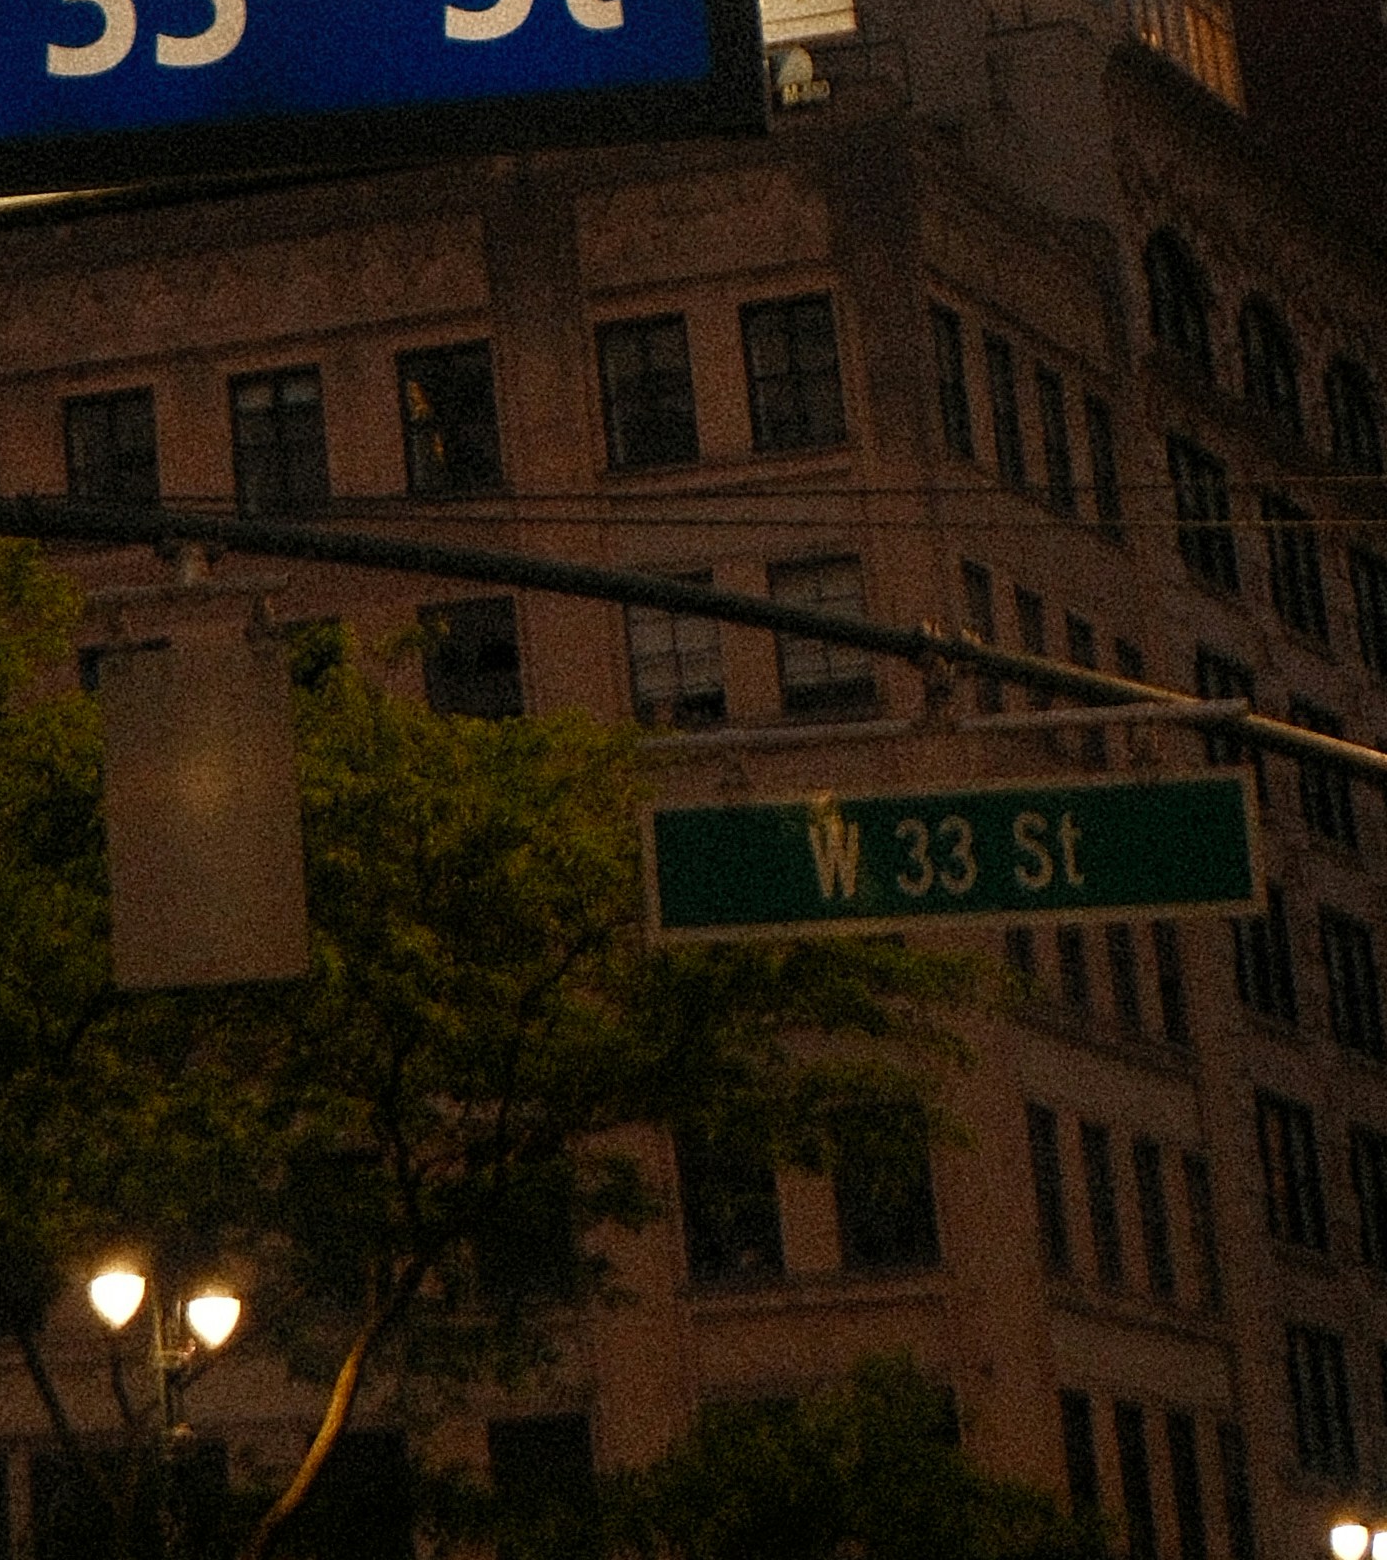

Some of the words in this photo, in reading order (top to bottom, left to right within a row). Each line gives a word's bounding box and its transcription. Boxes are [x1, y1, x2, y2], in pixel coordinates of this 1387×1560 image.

[809, 818, 861, 899] W
[895, 816, 979, 897] 33
[1012, 809, 1085, 890] St
